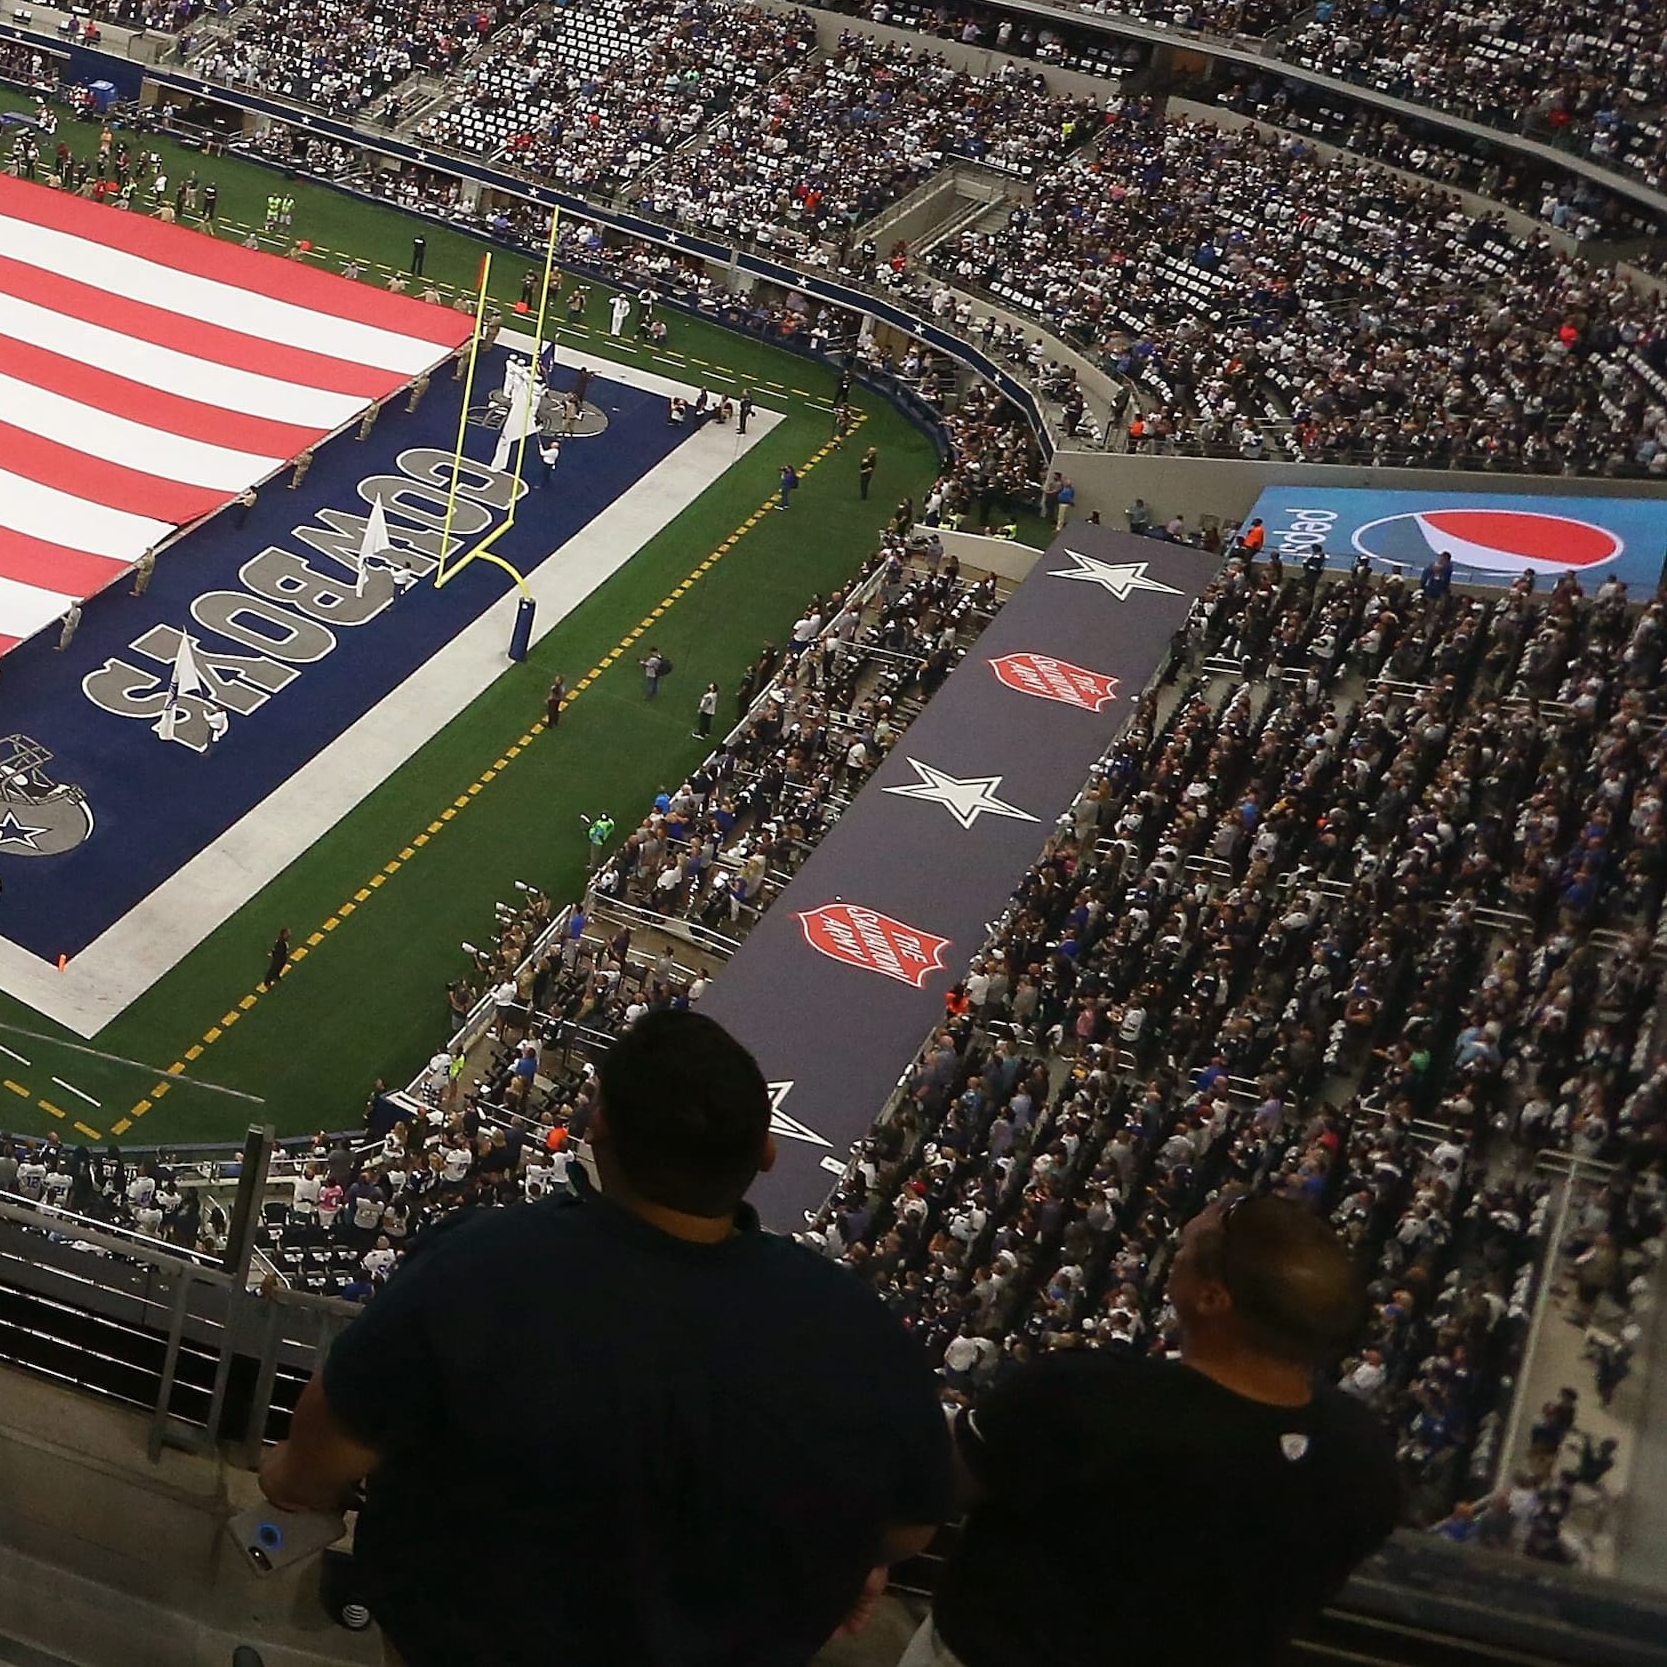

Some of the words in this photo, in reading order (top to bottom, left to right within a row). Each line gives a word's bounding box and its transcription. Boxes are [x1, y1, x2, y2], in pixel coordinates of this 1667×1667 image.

[81, 447, 530, 753] COWBOYS
[819, 912, 870, 962] ARMY
[846, 907, 911, 979] SALVATION
[890, 930, 929, 964] THE
